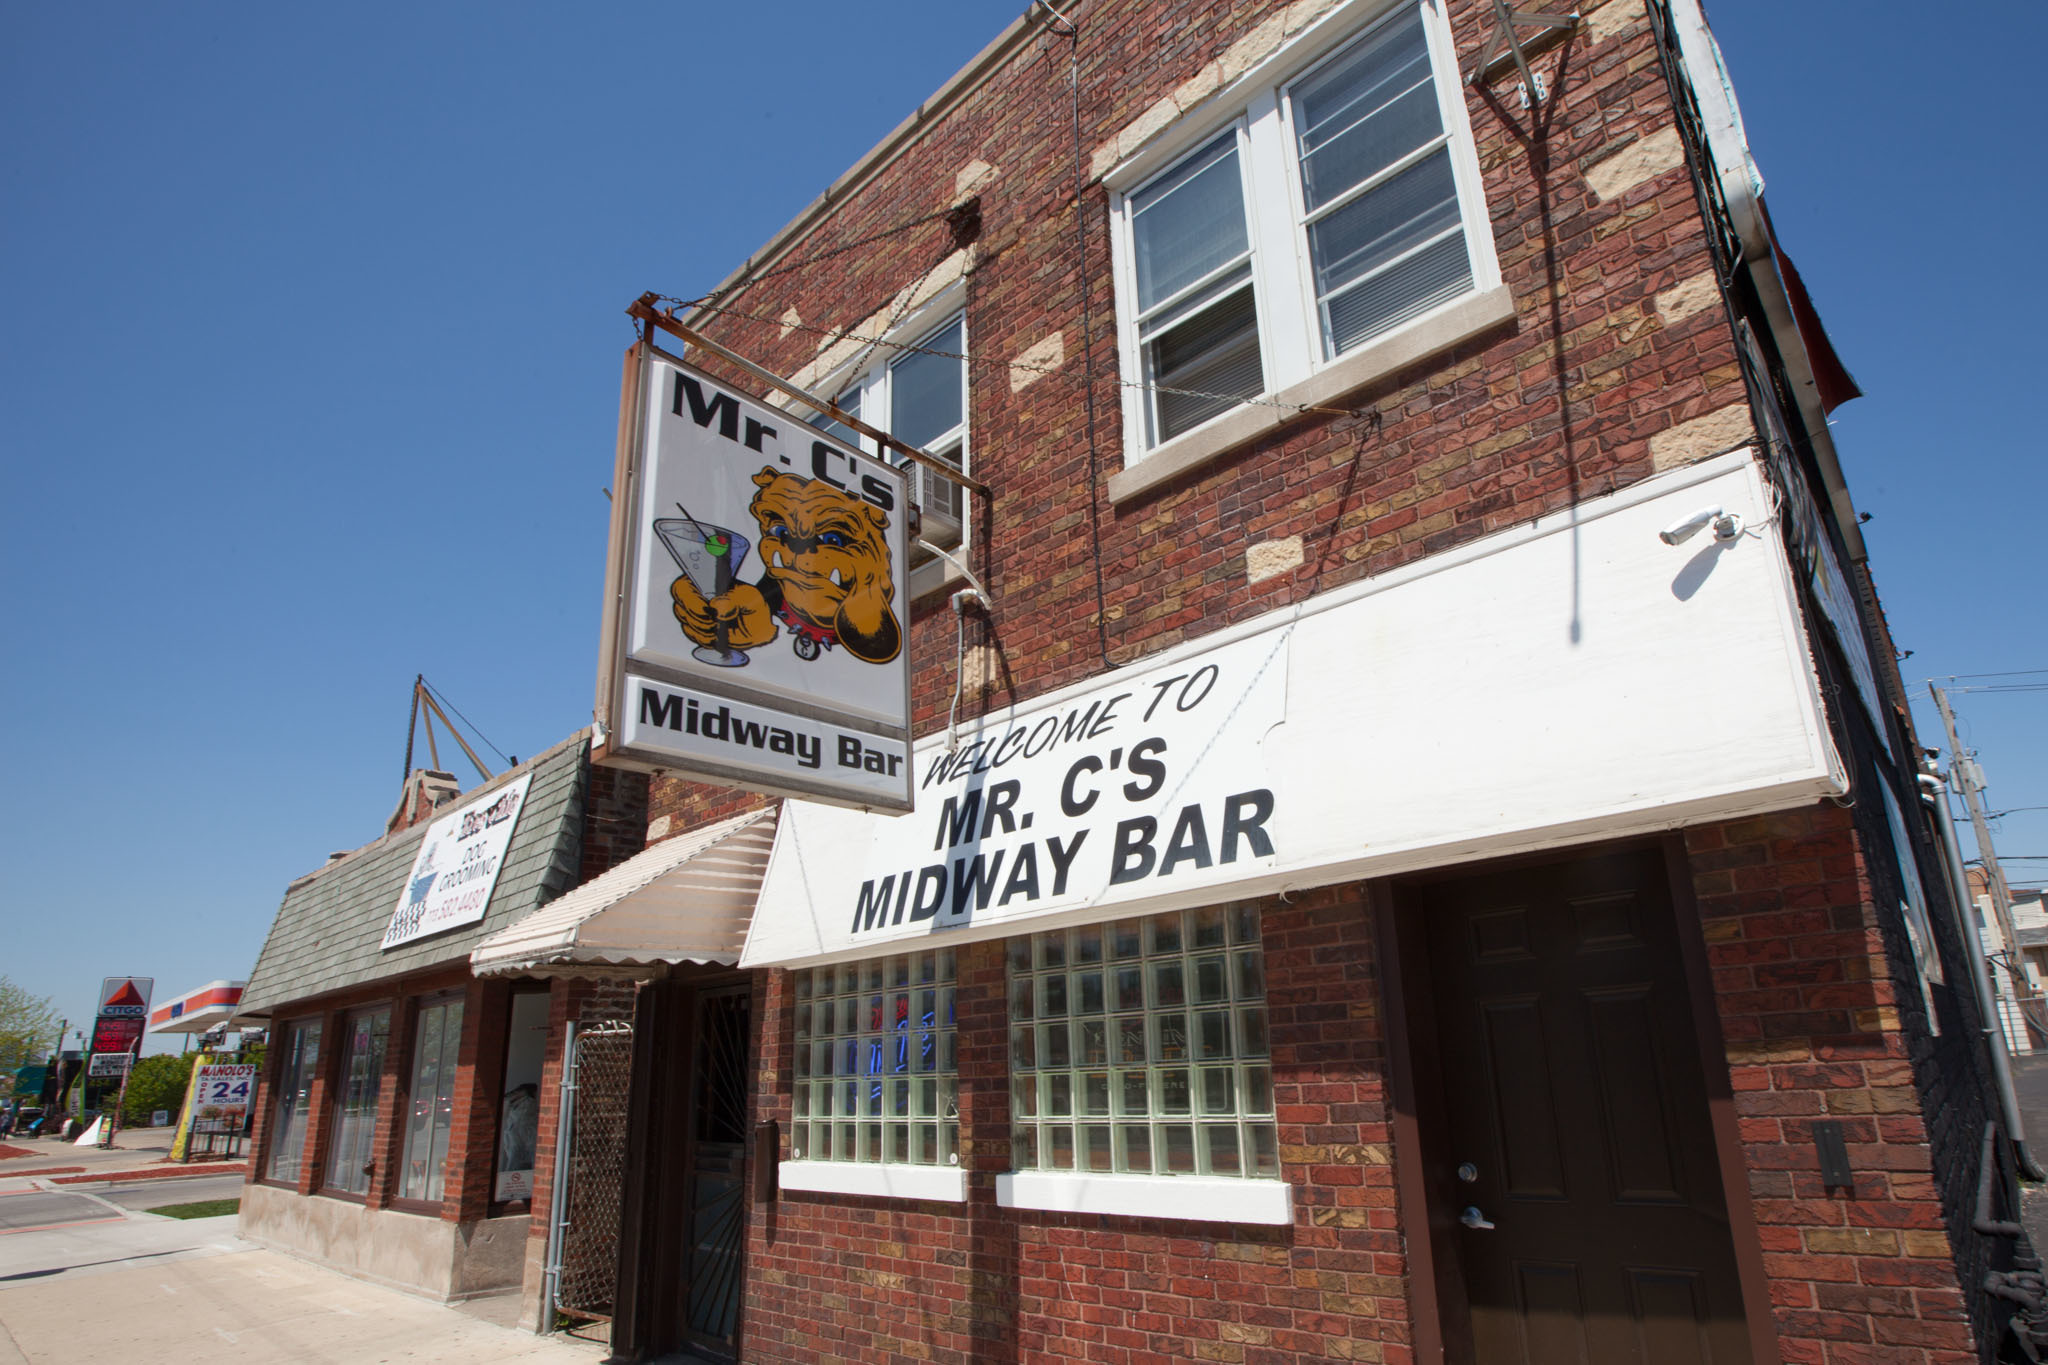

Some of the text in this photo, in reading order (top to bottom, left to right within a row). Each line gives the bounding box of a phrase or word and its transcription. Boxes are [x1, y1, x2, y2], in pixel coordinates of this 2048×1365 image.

[672, 370, 894, 513] Mr. C's
[640, 687, 903, 777] Midway Bar
[922, 664, 1219, 790] WELCOME TO
[934, 737, 1167, 851] MR. C'S
[439, 855, 497, 892] GROOMING
[463, 841, 487, 864] DOG
[851, 788, 1276, 933] MIDWAY BAR
[104, 1006, 143, 1014] CITGO
[200, 1065, 254, 1076] MANOLO'S
[212, 1081, 249, 1098] 24
